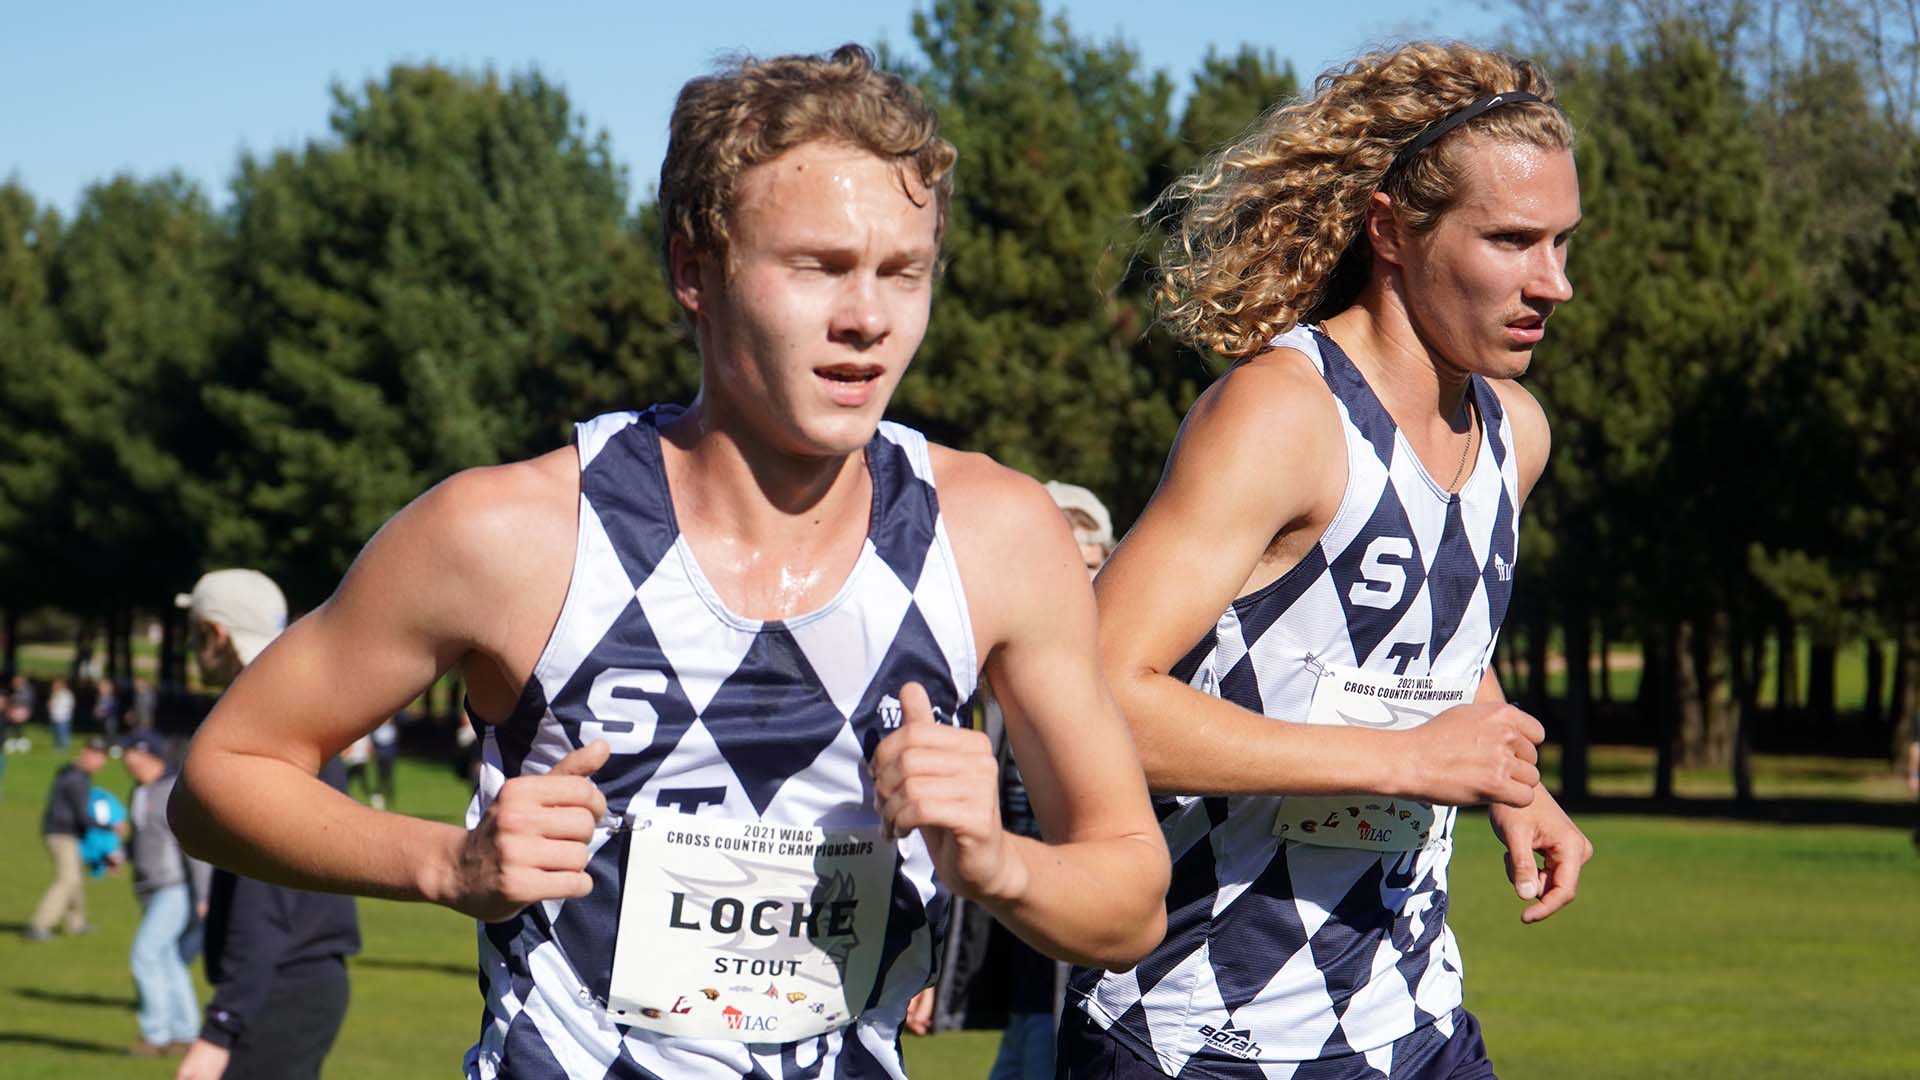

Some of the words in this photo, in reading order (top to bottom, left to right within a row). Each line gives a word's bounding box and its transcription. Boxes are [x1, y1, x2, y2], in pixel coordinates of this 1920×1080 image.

[1344, 681, 1376, 696] CROSS
[1377, 687, 1413, 700] COUNTRY
[1413, 690, 1464, 701] CHAMPIONSHIPS
[1397, 678, 1415, 689] 2021
[1416, 679, 1433, 689] WIAC
[744, 825, 775, 839] 2021
[779, 828, 813, 842] WIAC
[1359, 827, 1392, 842] WIAC
[667, 831, 710, 848] CROSS
[715, 836, 775, 854] COUNTRY
[778, 841, 874, 857] CHAMPIONSHIPS
[669, 892, 859, 938] LOCKE
[714, 957, 802, 977] STOUT
[724, 1012, 778, 1031] WIAC
